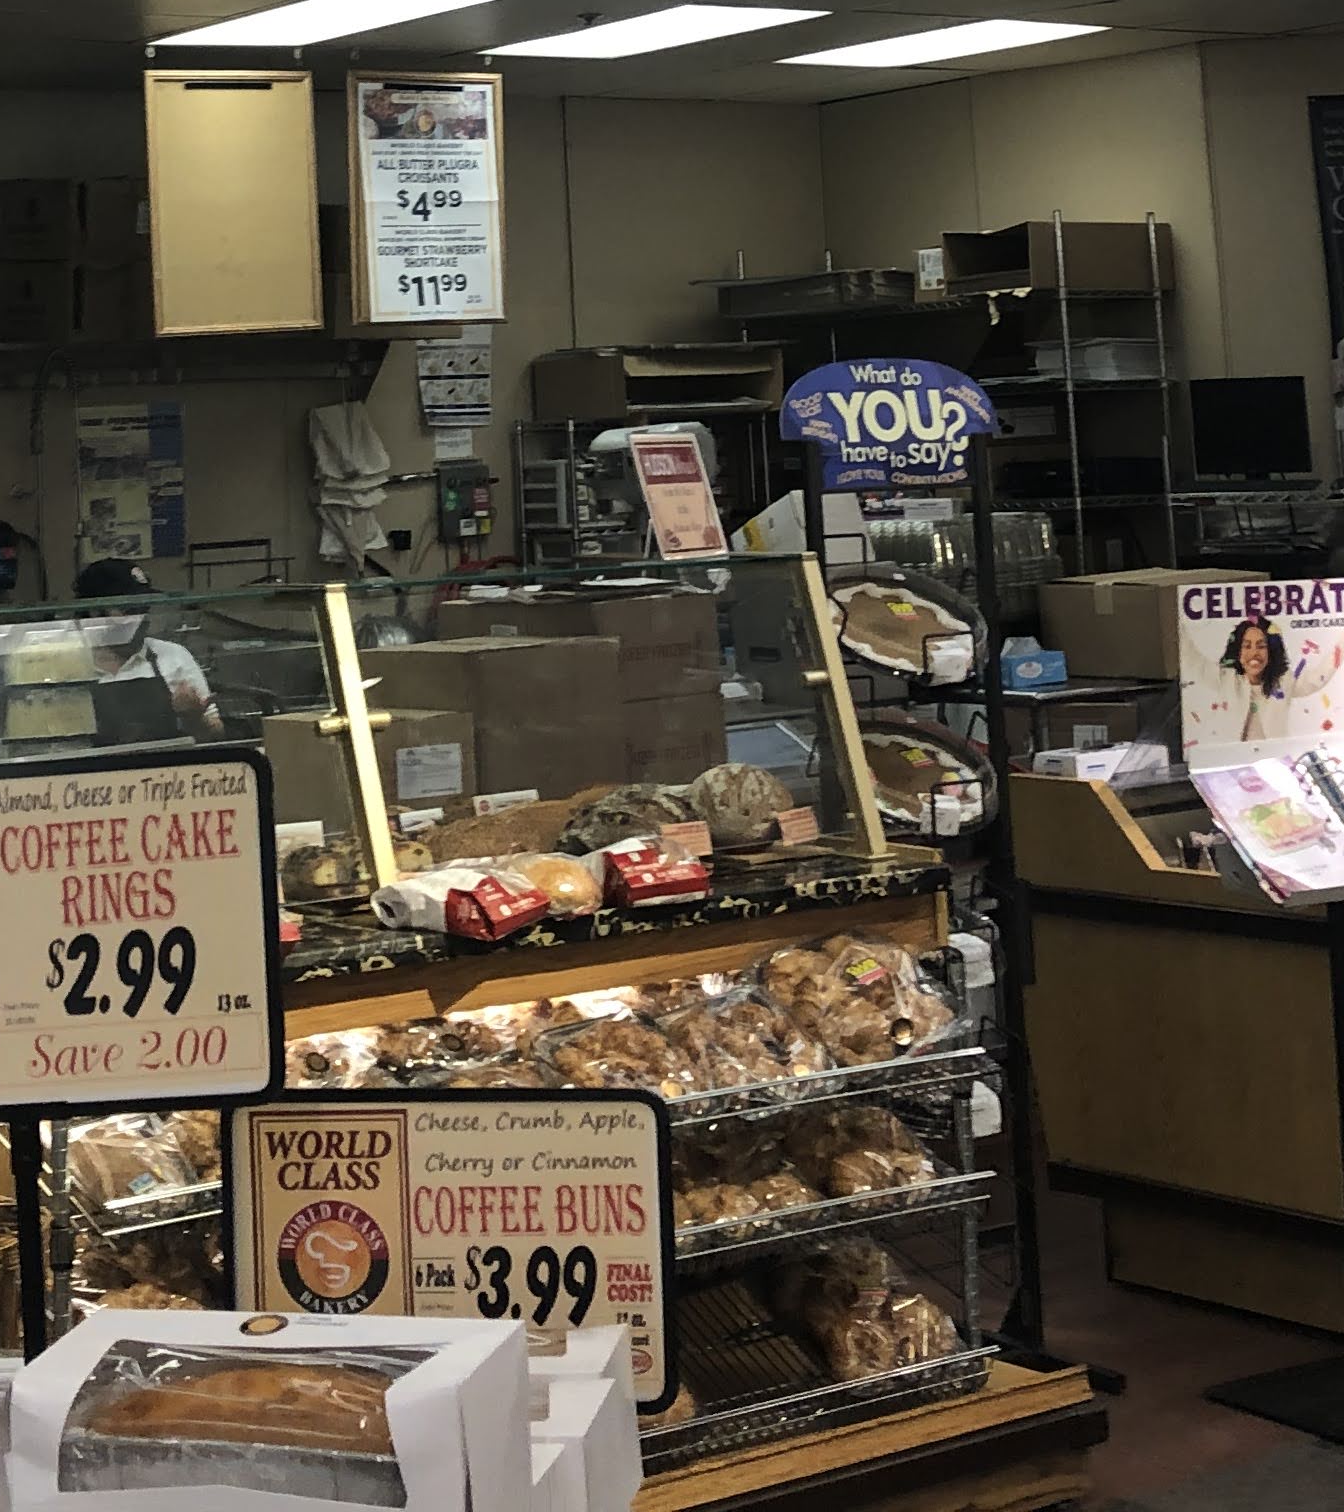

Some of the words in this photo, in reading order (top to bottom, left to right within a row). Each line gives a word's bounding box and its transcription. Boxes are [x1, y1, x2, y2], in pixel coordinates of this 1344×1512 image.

[377, 158, 396, 171] ALL
[398, 158, 434, 171] BUTTER
[397, 172, 460, 185] CROISSANTS
[377, 245, 419, 256] GOURMET
[422, 244, 487, 256] STRAWBERRY
[404, 257, 459, 268] SHORTCAKE
[849, 364, 896, 384] What
[900, 366, 922, 386] do
[840, 441, 888, 463] have
[890, 452, 906, 468] to
[63, 783, 114, 809] Cheese
[119, 785, 135, 803] or
[140, 777, 186, 813] Triple
[191, 772, 247, 799] Fruited
[0, 817, 132, 874] COFFEE
[141, 808, 241, 865] CAKE
[61, 869, 178, 927] RINGS
[46, 926, 196, 1018] $2.99
[29, 1033, 124, 1078] Save
[139, 1025, 228, 1070] 2.00
[415, 1111, 487, 1133] Cheese,
[495, 1109, 572, 1133] Crumb,
[578, 1109, 646, 1135] Apple,
[265, 1130, 392, 1159] WORLD
[277, 1161, 381, 1190] CLASS
[425, 1152, 494, 1178] Cherry
[502, 1156, 524, 1171] or
[531, 1150, 637, 1171] Cinnamon
[414, 1186, 545, 1236] COFFEE
[556, 1184, 646, 1235] BUNS
[280, 1205, 331, 1250] WORLD
[338, 1205, 384, 1251] CLASS
[426, 1261, 456, 1289] Pack
[464, 1245, 597, 1327] $3.99
[607, 1262, 653, 1282] FINAL
[299, 1288, 371, 1315] BAKERY
[607, 1283, 654, 1302] COST!
